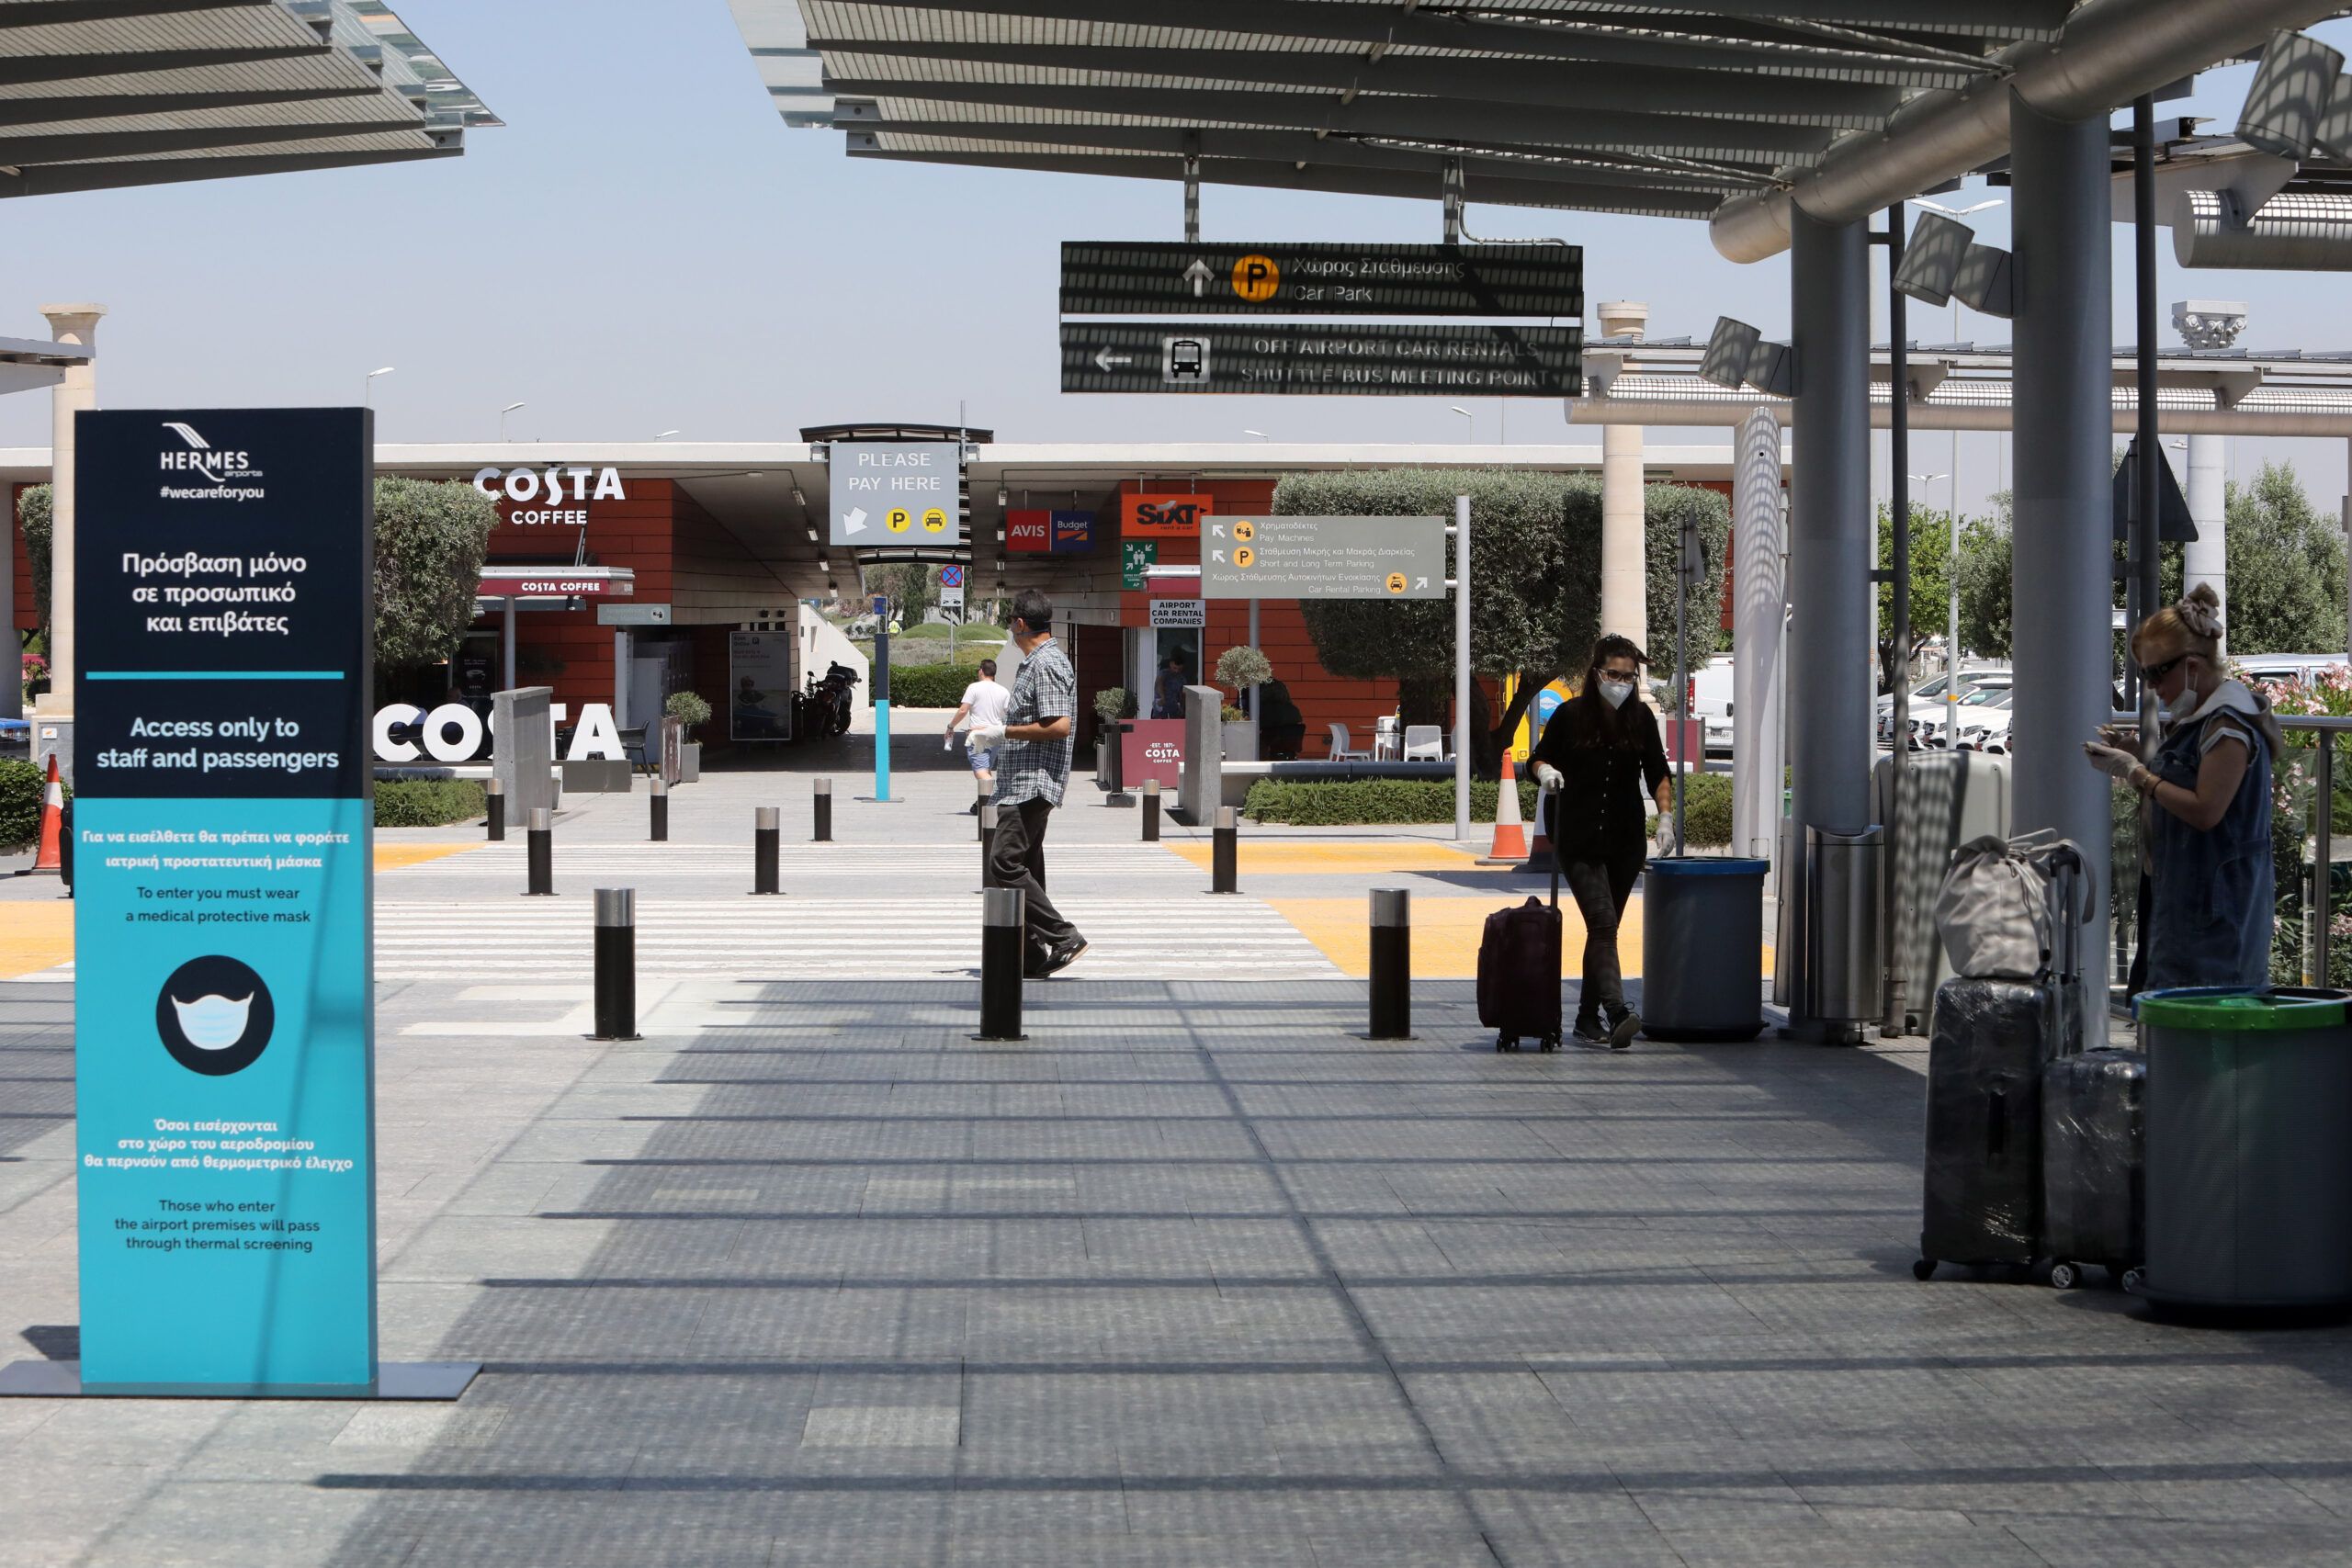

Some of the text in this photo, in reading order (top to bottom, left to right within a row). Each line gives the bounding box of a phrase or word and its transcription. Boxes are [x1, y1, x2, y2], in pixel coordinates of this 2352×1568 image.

[1293, 257, 1355, 277] Χώρος
[1247, 263, 1268, 293] P
[1294, 286, 1373, 302] Car Park
[1299, 339, 1388, 356] AIRPORT
[1396, 340, 1440, 356] CAR
[1446, 340, 1539, 357] RENTALS
[1240, 367, 1550, 387] SHUTTLE BUS MEETING POINT
[160, 451, 249, 479] HERMES
[858, 452, 932, 467] PLEASE
[472, 467, 626, 507] COSTA
[848, 477, 941, 491] PAY HERE
[160, 484, 265, 502] #wecareforyou
[511, 510, 588, 525] COFFEE
[892, 512, 906, 529] P
[1057, 520, 1088, 531] Budget
[1011, 525, 1046, 537] AVIS
[1260, 522, 1318, 532] Χρηματοδέκτες
[1259, 534, 1315, 543] Pay Machines
[1240, 551, 1250, 564] P
[1259, 547, 1302, 557] Στάθμευση
[1303, 547, 1331, 558] Μικρής
[1346, 547, 1376, 558] Μακράς
[122, 551, 307, 579] Πρόσβαση μόνο
[1260, 559, 1374, 570] Short and Long Term Parking
[1212, 573, 1239, 583] Χώρος
[1240, 572, 1287, 583] Στάθμευσης
[131, 581, 297, 607] σε προσωπικό
[521, 581, 600, 592] COSTA COFFEE
[1308, 585, 1381, 595] Car Rental Parking
[1151, 609, 1170, 617] CAR
[146, 610, 289, 637] και επιβάτες
[1153, 617, 1202, 626] COMPANIES
[130, 716, 300, 743] Access only to
[96, 747, 340, 773] staff and passengers
[1145, 749, 1180, 759] COSTA
[82, 830, 350, 846] Για να εισέλθετε θα πρέπει να φοράτε
[106, 854, 322, 871] ιατρική προστατευτική μάσκα
[136, 886, 300, 902] To enter you must wear
[125, 910, 311, 925] a medical protective mask
[153, 1118, 278, 1134] Όσοι εισέρχονται
[118, 1136, 315, 1153] στο χώρο του αεροδρομίου
[84, 1154, 354, 1172] θα περνούν από θερμομετρικό έλεγχο
[159, 1200, 276, 1213] Those who enter
[115, 1218, 321, 1235] the airport premises will pass
[126, 1236, 312, 1254] through thermal screening
